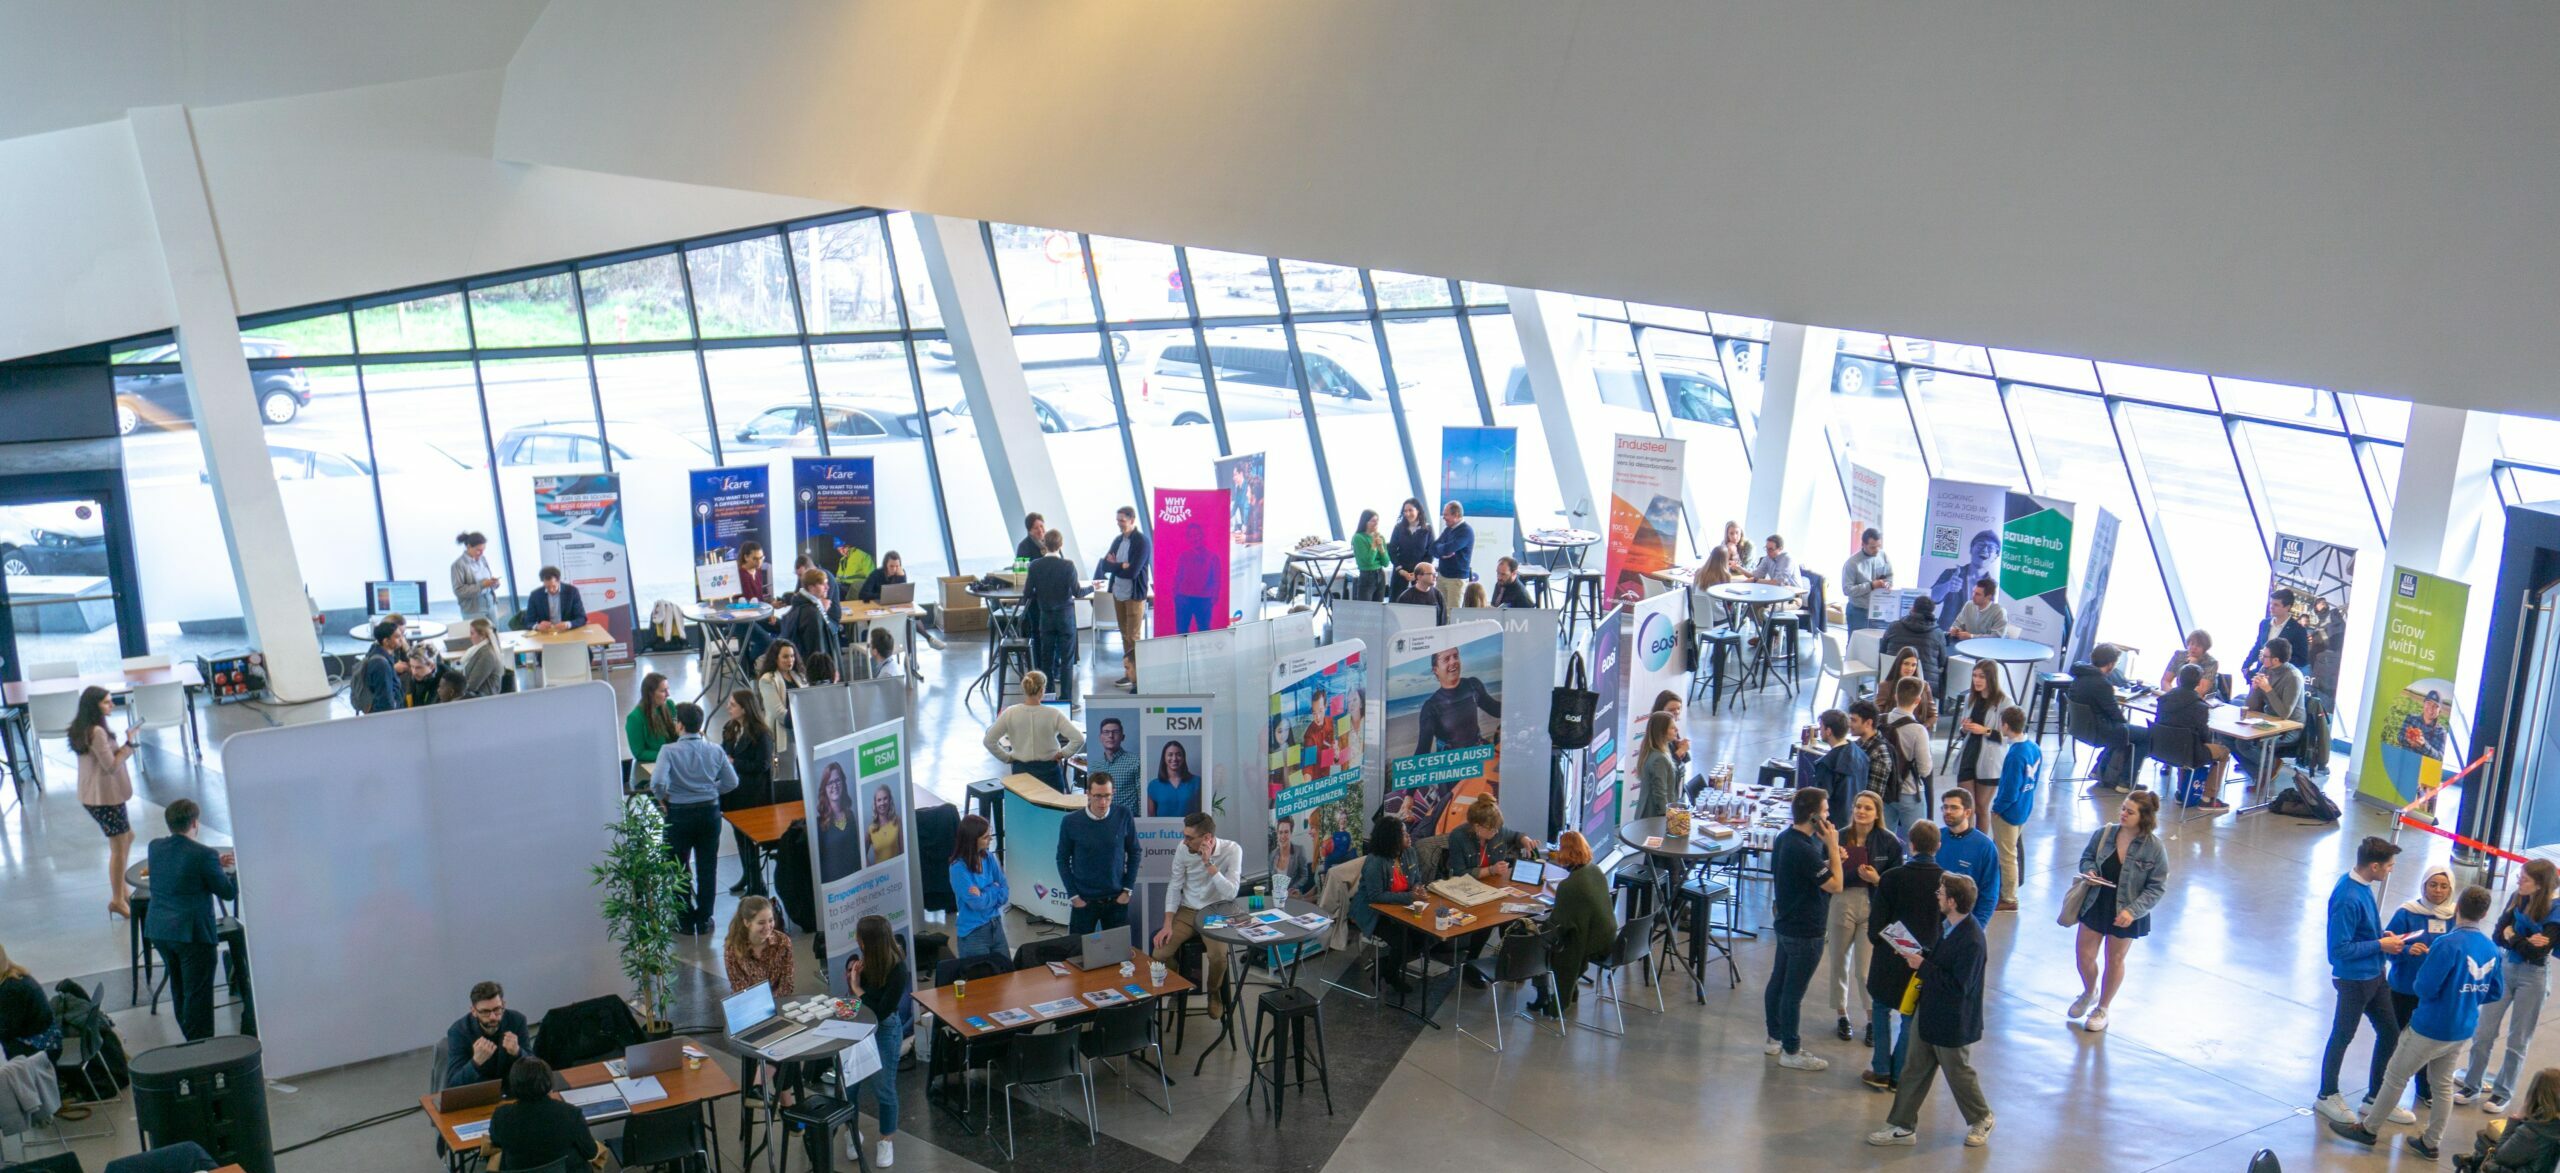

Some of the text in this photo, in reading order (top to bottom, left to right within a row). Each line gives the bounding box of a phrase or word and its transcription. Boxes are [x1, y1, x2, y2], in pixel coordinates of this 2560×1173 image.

[1618, 438, 1667, 452] Industeel
[1165, 497, 1186, 506] WHY
[1937, 492, 1974, 502] LOOKING
[1159, 508, 1192, 523] TODAY?
[1166, 505, 1184, 514] NOT
[1936, 511, 1991, 523] ENGINEERING
[2004, 530, 2063, 550] squarehub
[2003, 551, 2054, 569] Start To Build
[2002, 562, 2048, 578] Your Career
[2392, 618, 2425, 640] Grow
[1652, 630, 1678, 654] easi
[2389, 638, 2435, 661] with us
[1602, 647, 1616, 673] easi
[1166, 717, 1202, 730] RSM
[1565, 714, 1581, 722] easi
[875, 750, 895, 766] RSM
[1395, 748, 1491, 771] YES, C'EST ÇA AUSSI
[1395, 765, 1480, 787] LE SPF FINANCES.
[1278, 769, 1360, 801] YES, AUCH DAFÜR STEHT
[1278, 788, 1345, 816] DER FÖD FINANZEN.
[1160, 829, 1184, 839] futu
[1144, 848, 1176, 857] journe
[828, 874, 889, 903] Empowering you
[830, 882, 902, 917] to take the next step
[830, 921, 838, 930] in
[840, 916, 855, 929] your
[888, 910, 905, 920] Team
